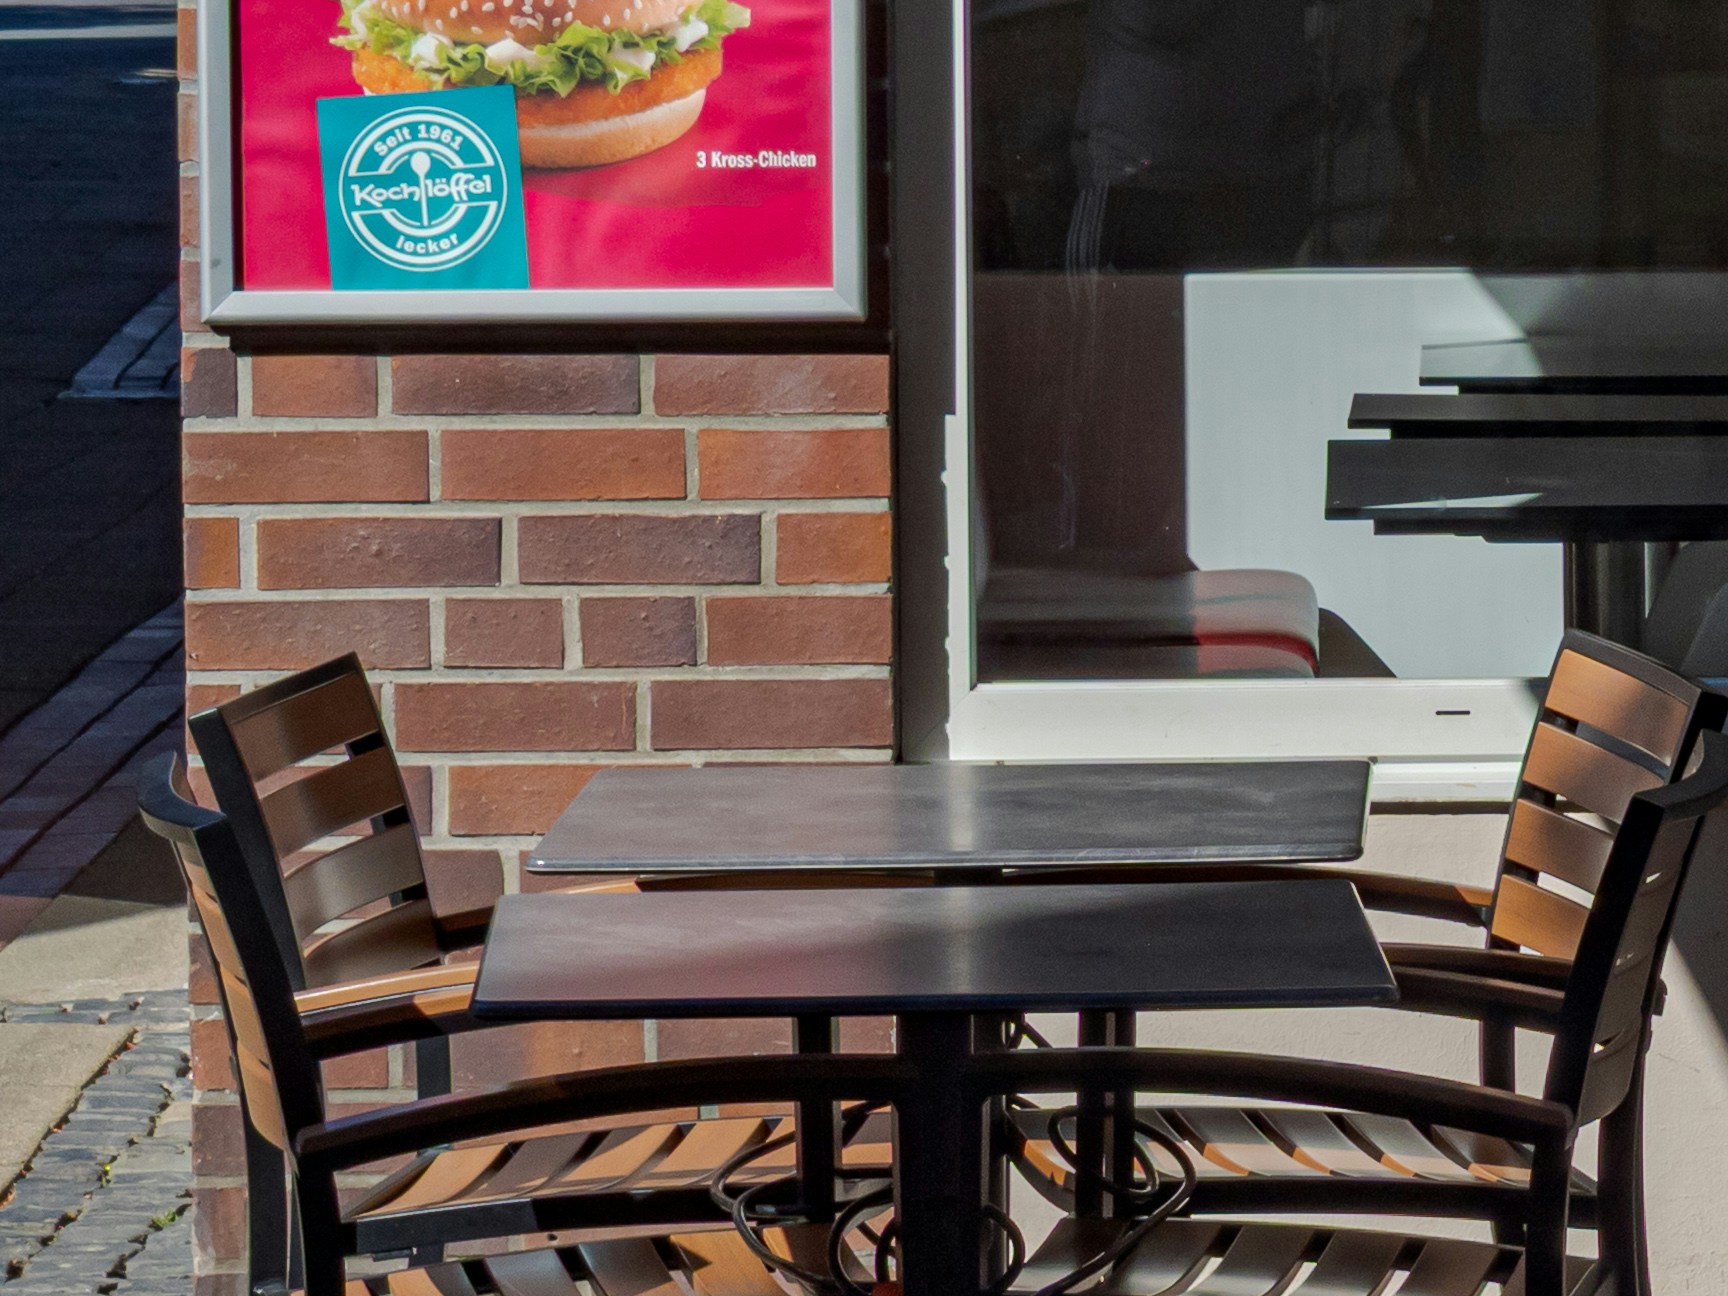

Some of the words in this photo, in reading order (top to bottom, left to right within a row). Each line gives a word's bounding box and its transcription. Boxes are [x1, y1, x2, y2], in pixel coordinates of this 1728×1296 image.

[374, 128, 412, 156] Seit
[418, 124, 464, 150] 1961
[696, 150, 707, 168] 3
[711, 150, 817, 168] Kross-Chicken
[395, 233, 459, 254] lecker
